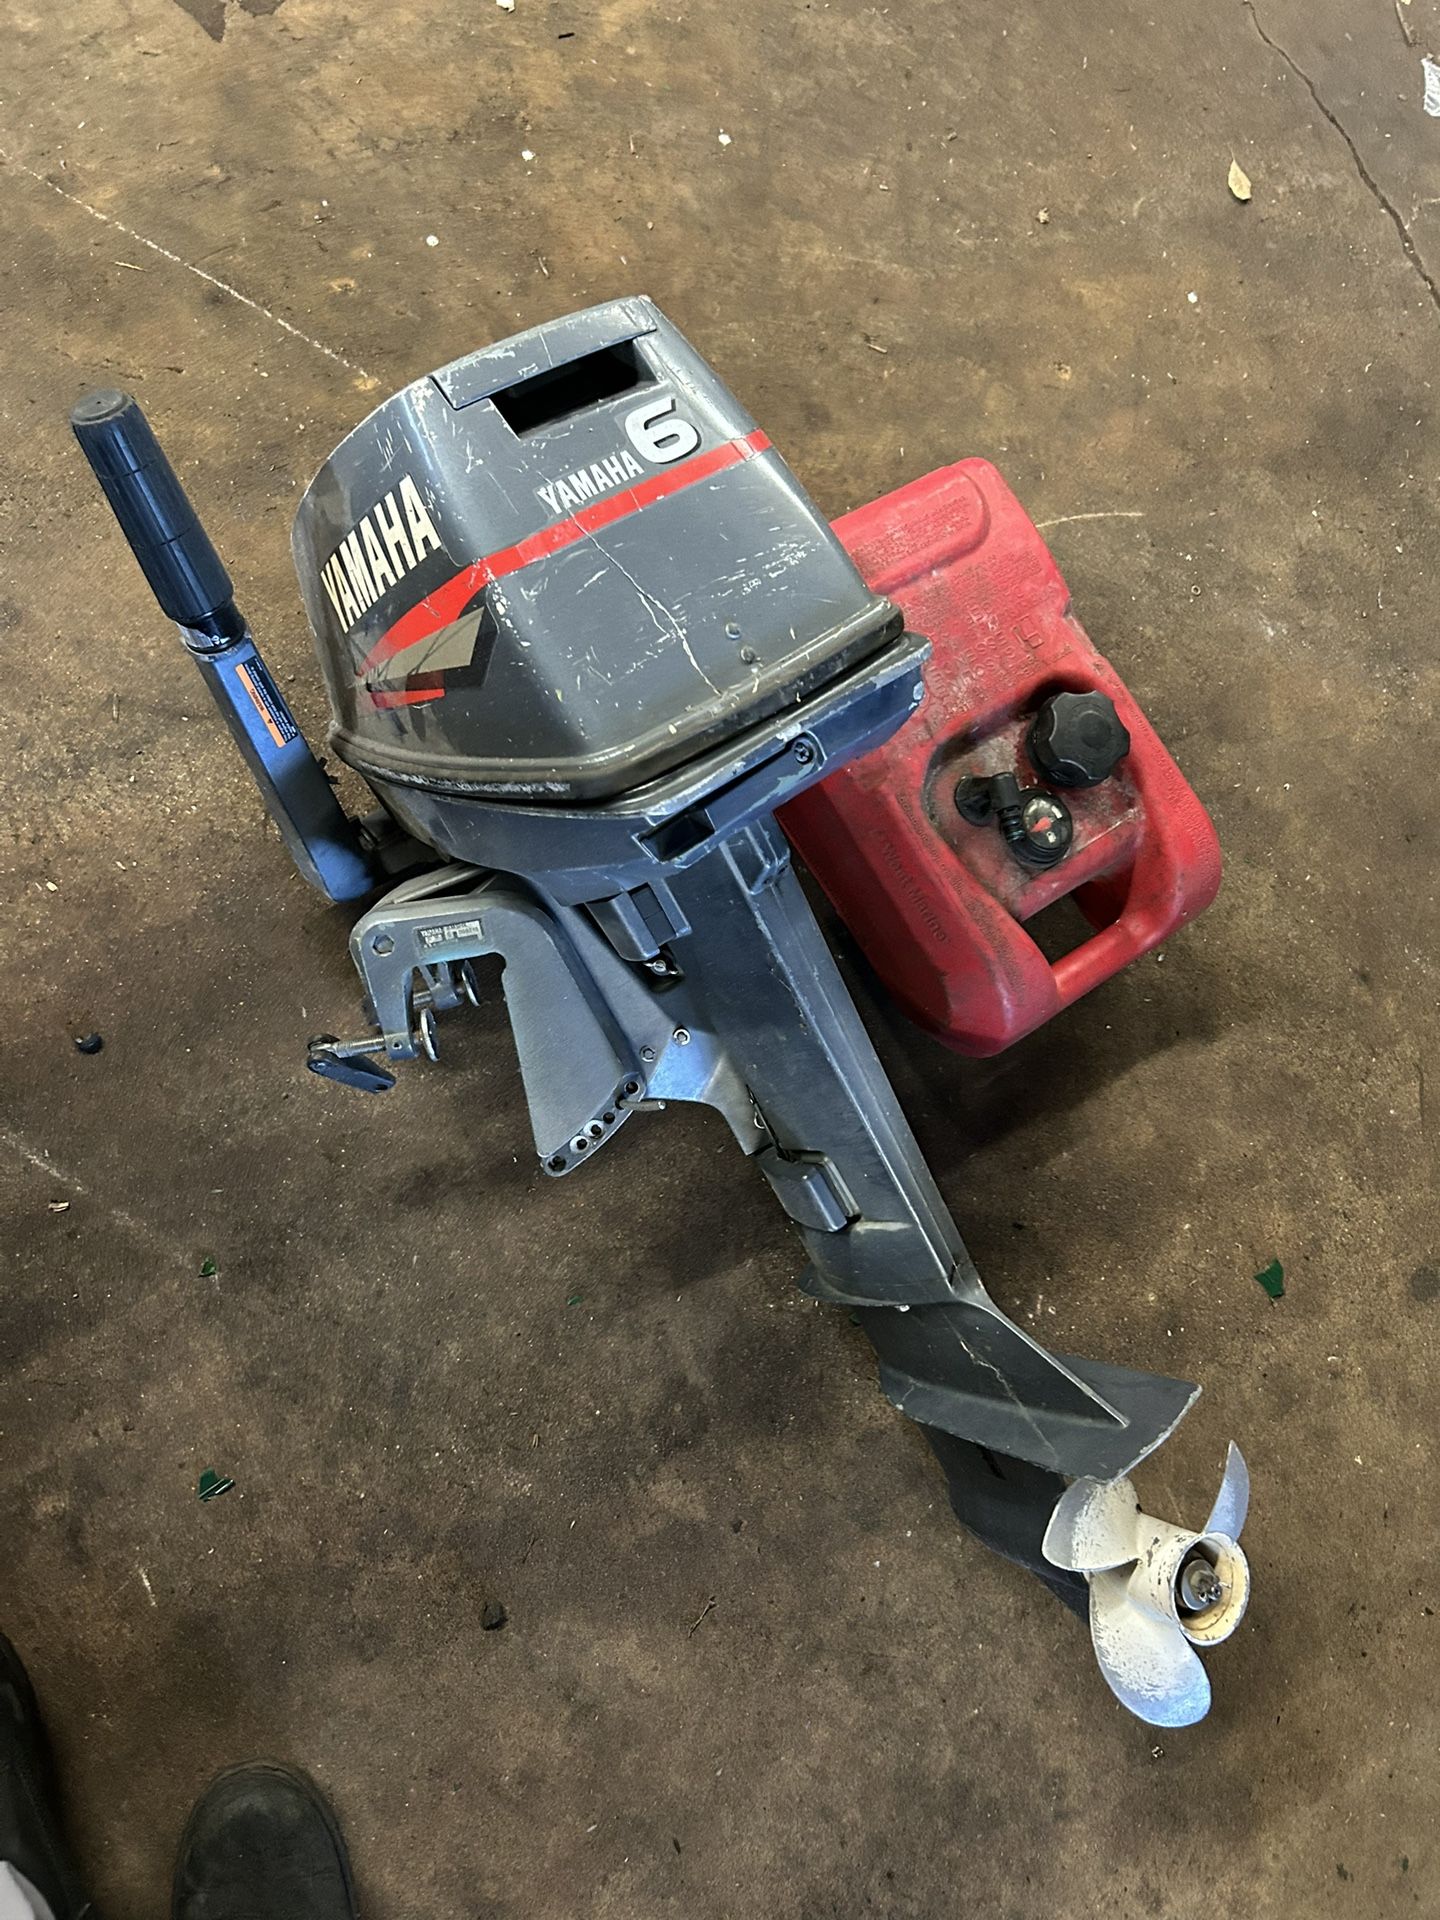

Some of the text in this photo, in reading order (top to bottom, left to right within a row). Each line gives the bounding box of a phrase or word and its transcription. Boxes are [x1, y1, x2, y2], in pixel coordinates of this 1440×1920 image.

[537, 396, 702, 514] YAMAHA 6
[320, 474, 442, 634] YAMAHA
